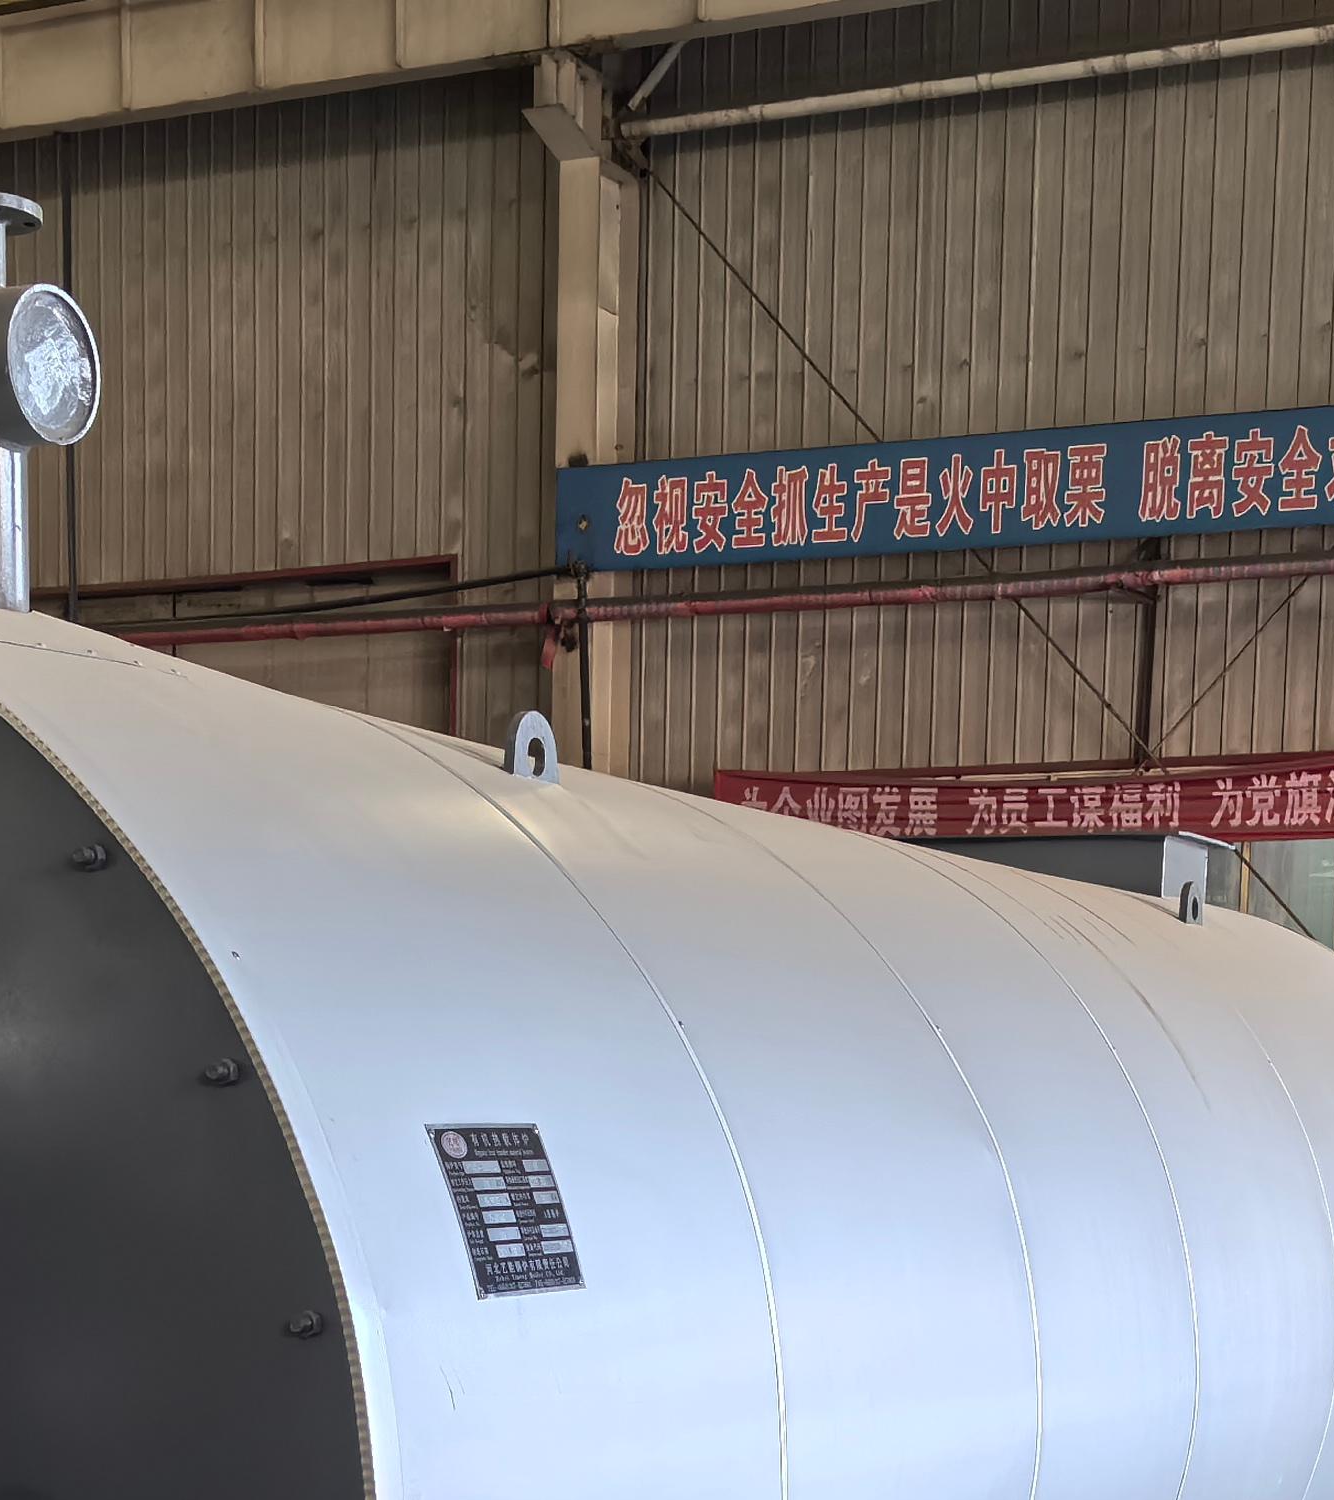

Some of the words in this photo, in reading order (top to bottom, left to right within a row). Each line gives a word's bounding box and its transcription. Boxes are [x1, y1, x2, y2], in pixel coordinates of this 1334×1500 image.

[614, 443, 1108, 556] 忽视安全抓生产是火中取栗
[966, 781, 1180, 835] 为员工谋福利
